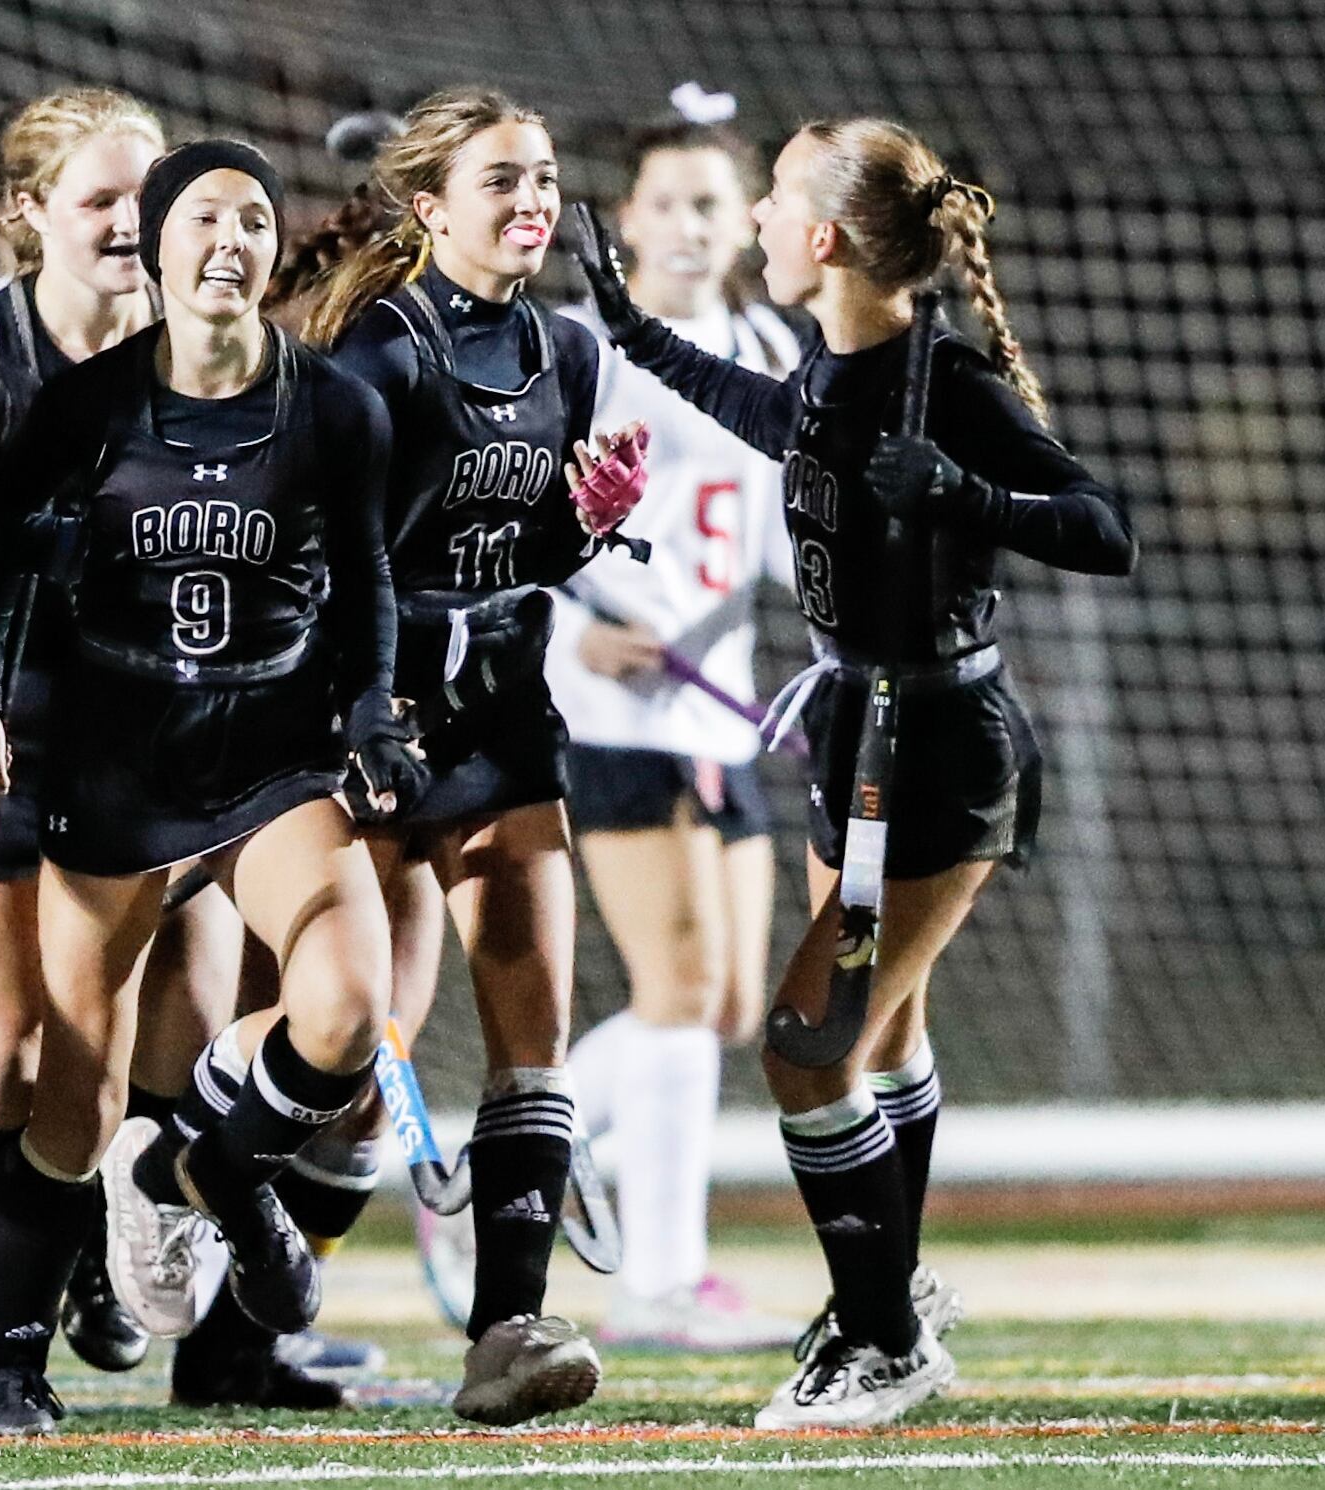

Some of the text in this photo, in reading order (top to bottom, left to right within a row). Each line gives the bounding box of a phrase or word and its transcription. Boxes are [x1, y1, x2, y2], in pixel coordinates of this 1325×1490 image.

[442, 441, 552, 509] BORO
[782, 450, 838, 532] ORO
[132, 500, 276, 565] BORO
[448, 521, 522, 588] 11
[170, 569, 231, 655] 9
[792, 533, 838, 627] 3
